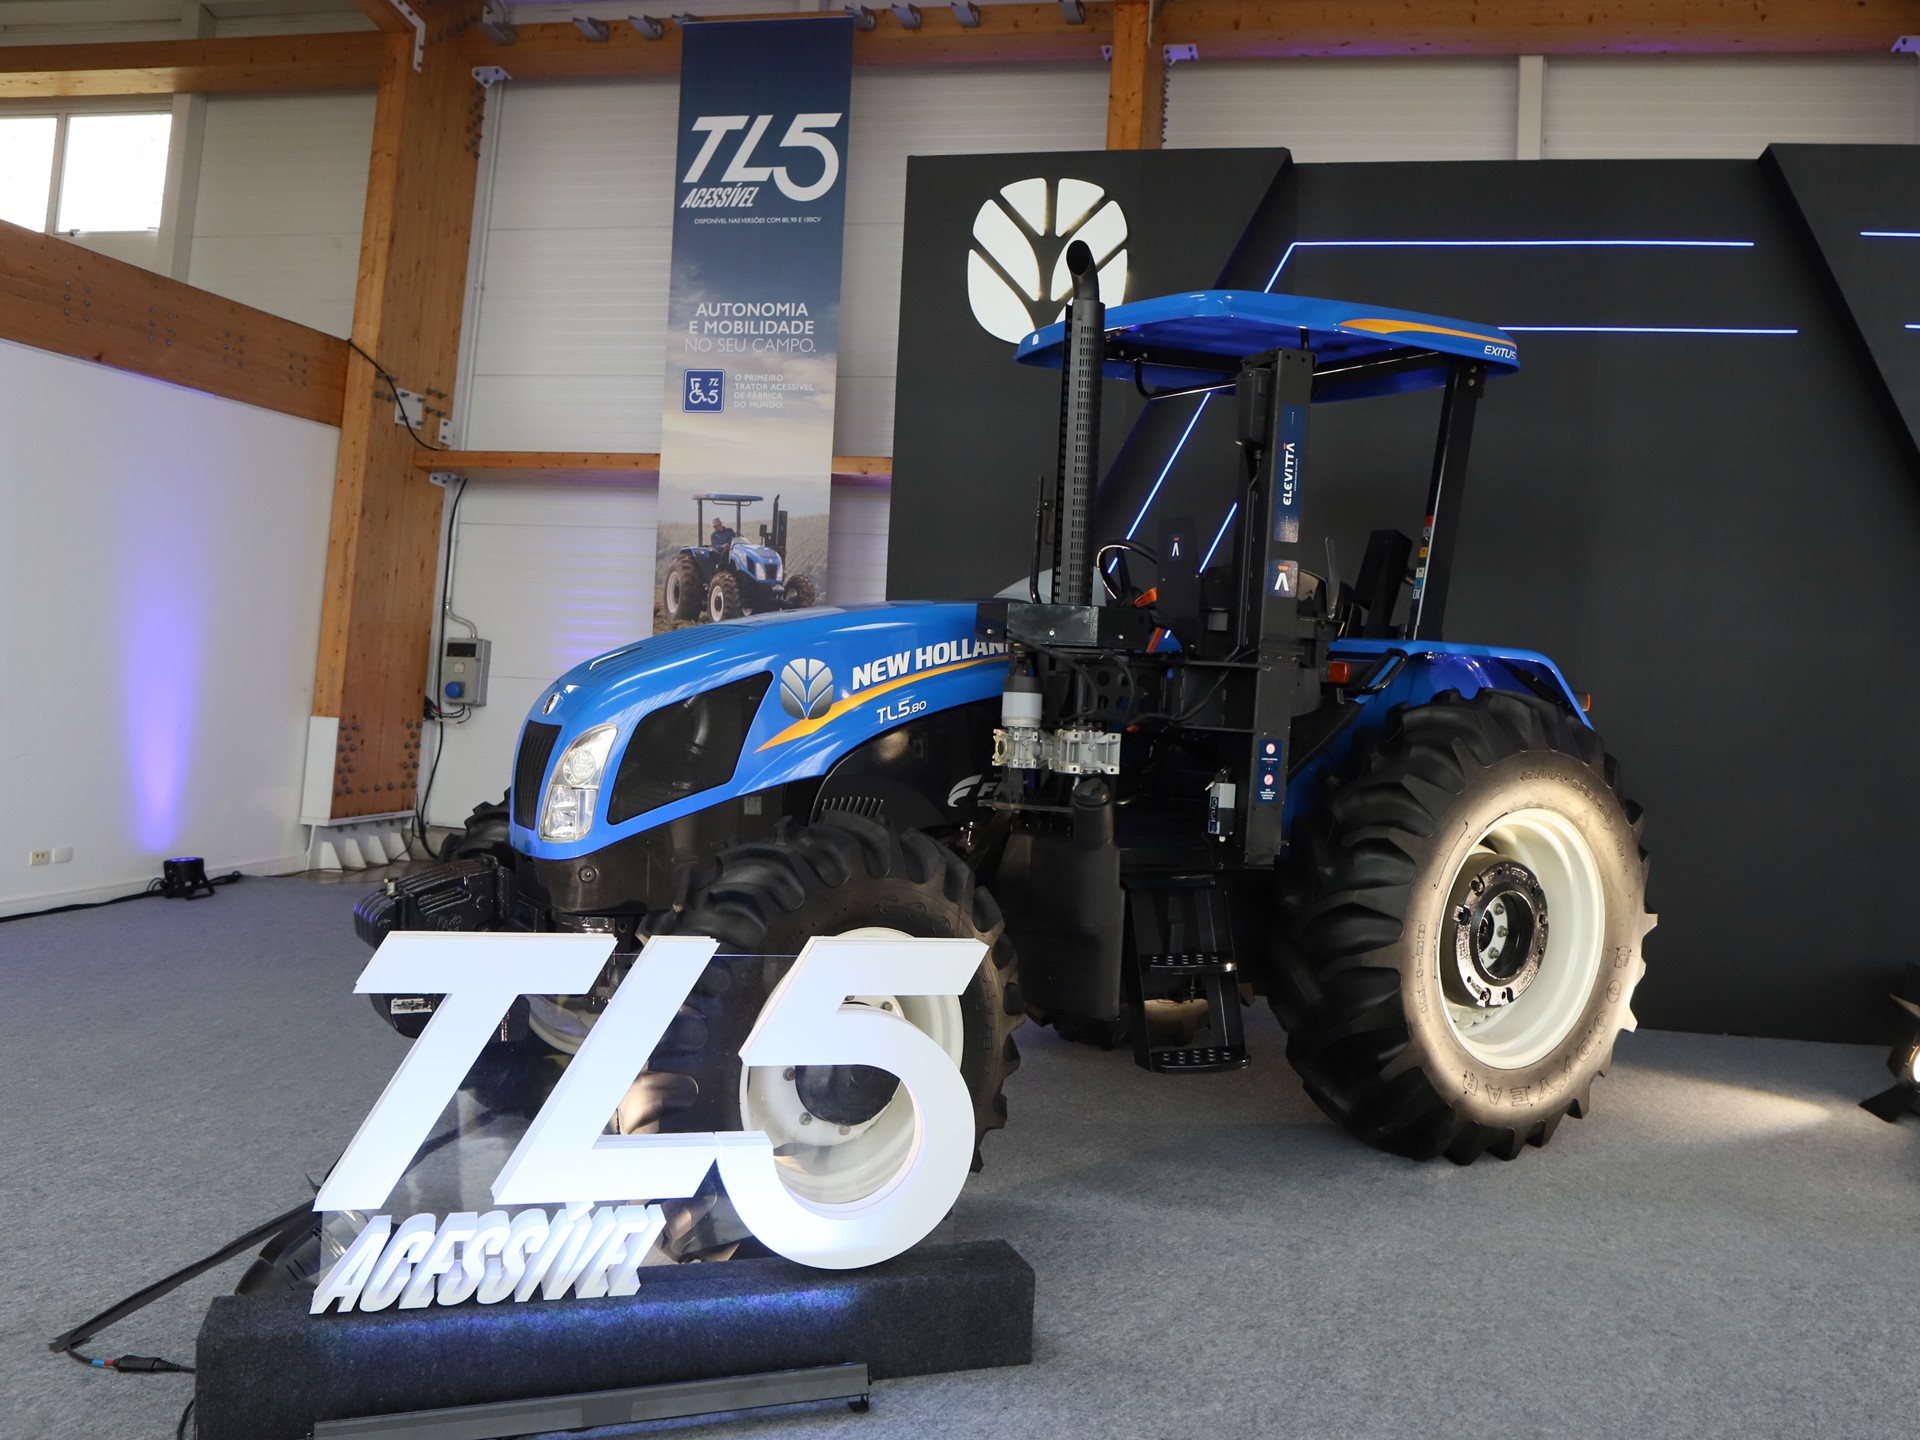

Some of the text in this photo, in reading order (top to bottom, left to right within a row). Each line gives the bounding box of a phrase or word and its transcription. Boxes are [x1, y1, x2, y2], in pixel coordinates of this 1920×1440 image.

[682, 112, 843, 202] TL5
[680, 182, 760, 209] ACESSÍVEL
[694, 217, 727, 225] DISPONÍVEL
[740, 215, 765, 224] VERSÕES
[766, 216, 781, 224] COM
[695, 302, 809, 317] AUTONOMIA
[689, 320, 815, 335] E MOBILIDADE
[685, 338, 817, 353] NO SEU CAMPO.
[1484, 345, 1516, 360] EXITUS
[734, 390, 783, 400] DE FÁBRICA
[749, 401, 785, 409] MUNDO.
[852, 651, 911, 691] NEW
[876, 699, 927, 724] TL5.80
[312, 931, 990, 1270] TL5
[309, 1201, 667, 1315] ACESSÍVEL
